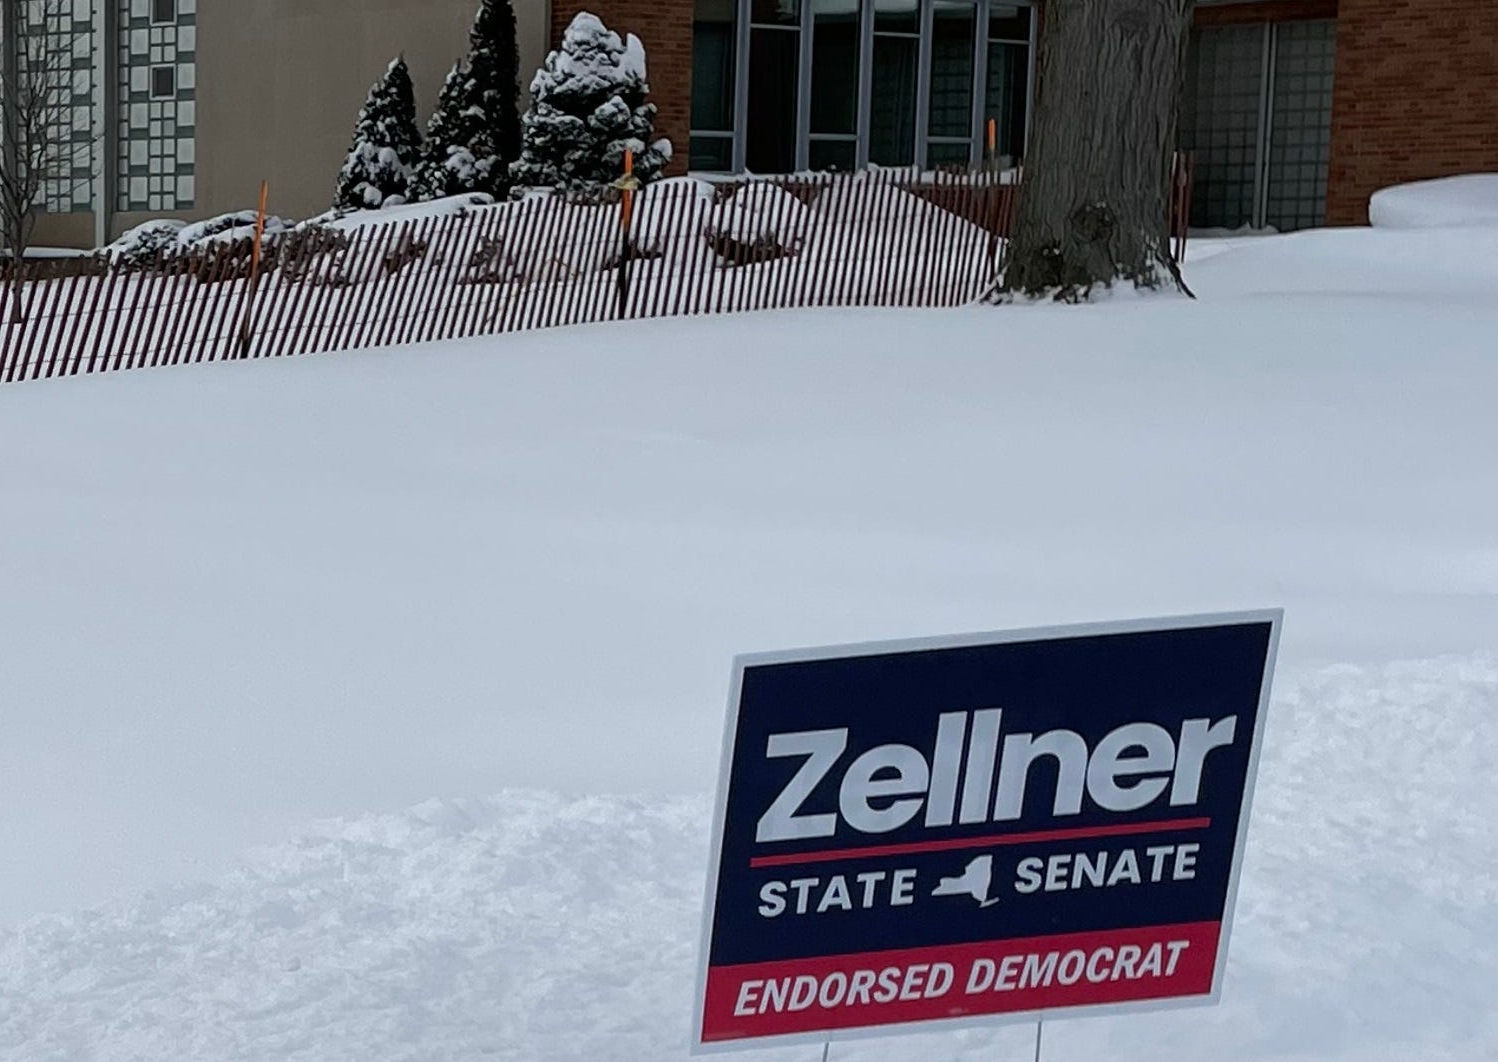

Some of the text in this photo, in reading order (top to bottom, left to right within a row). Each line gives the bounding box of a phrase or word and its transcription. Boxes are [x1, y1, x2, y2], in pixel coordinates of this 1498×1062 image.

[755, 708, 1237, 843] Zellner
[758, 843, 1201, 918] STATE SENATE
[733, 940, 1190, 1017] ENDORSED DEMOCRAT
